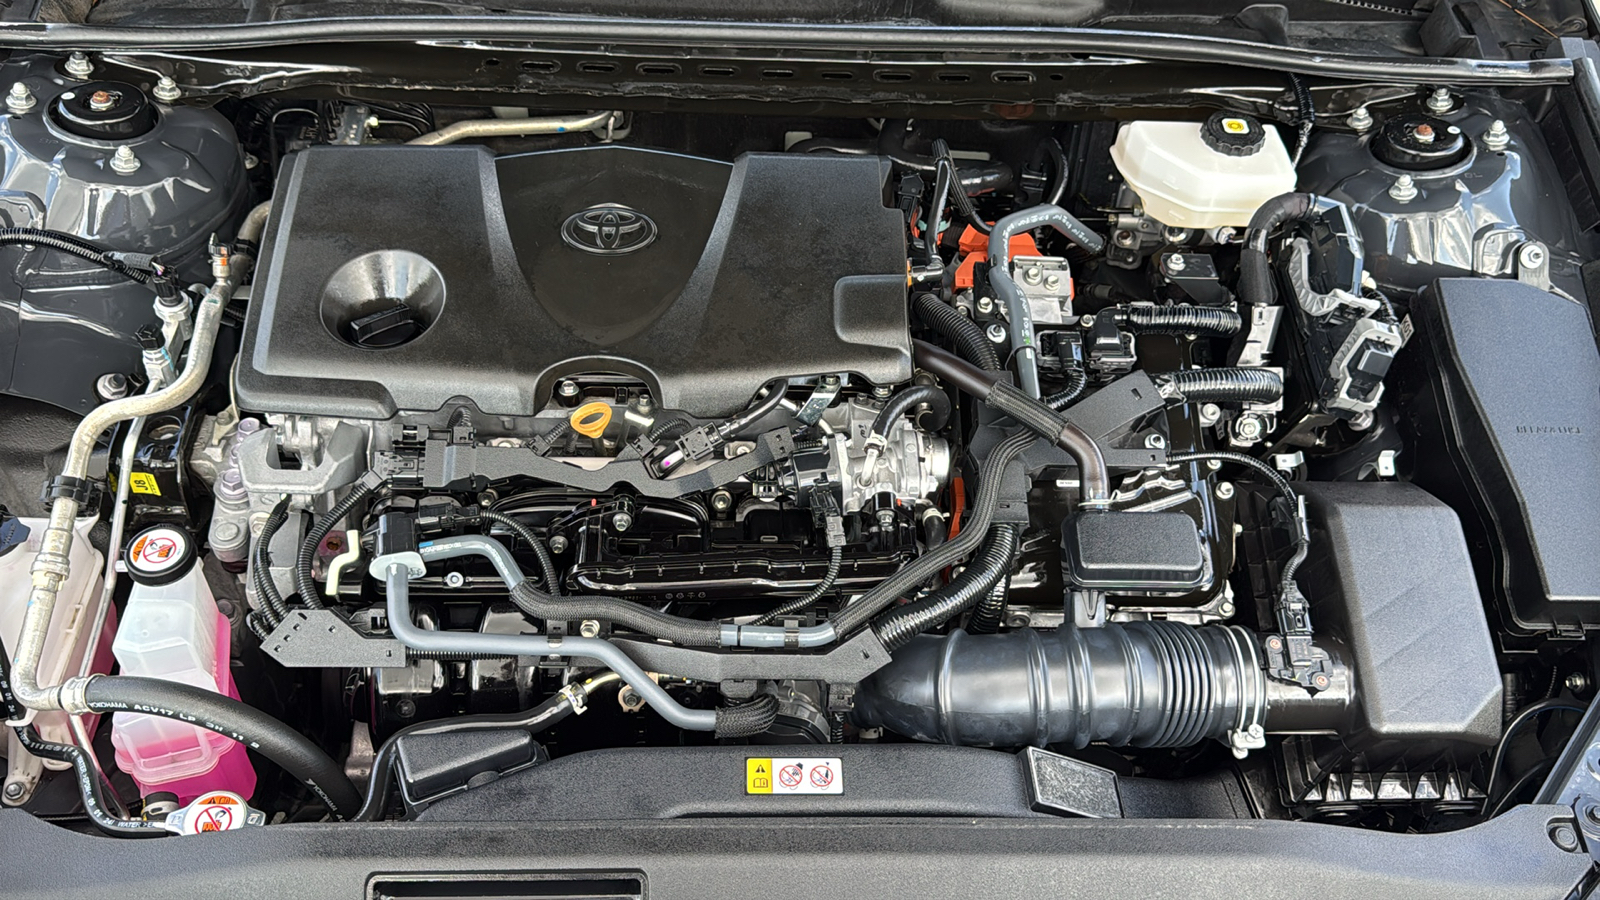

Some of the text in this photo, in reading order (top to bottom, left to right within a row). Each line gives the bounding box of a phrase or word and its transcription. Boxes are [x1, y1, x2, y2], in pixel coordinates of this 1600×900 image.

[133, 479, 149, 491] J8
[87, 701, 128, 710] YOKOHAMA
[133, 703, 174, 716] ACV17
[312, 784, 339, 812] YOKOHAMA
[117, 821, 142, 829] WATER
